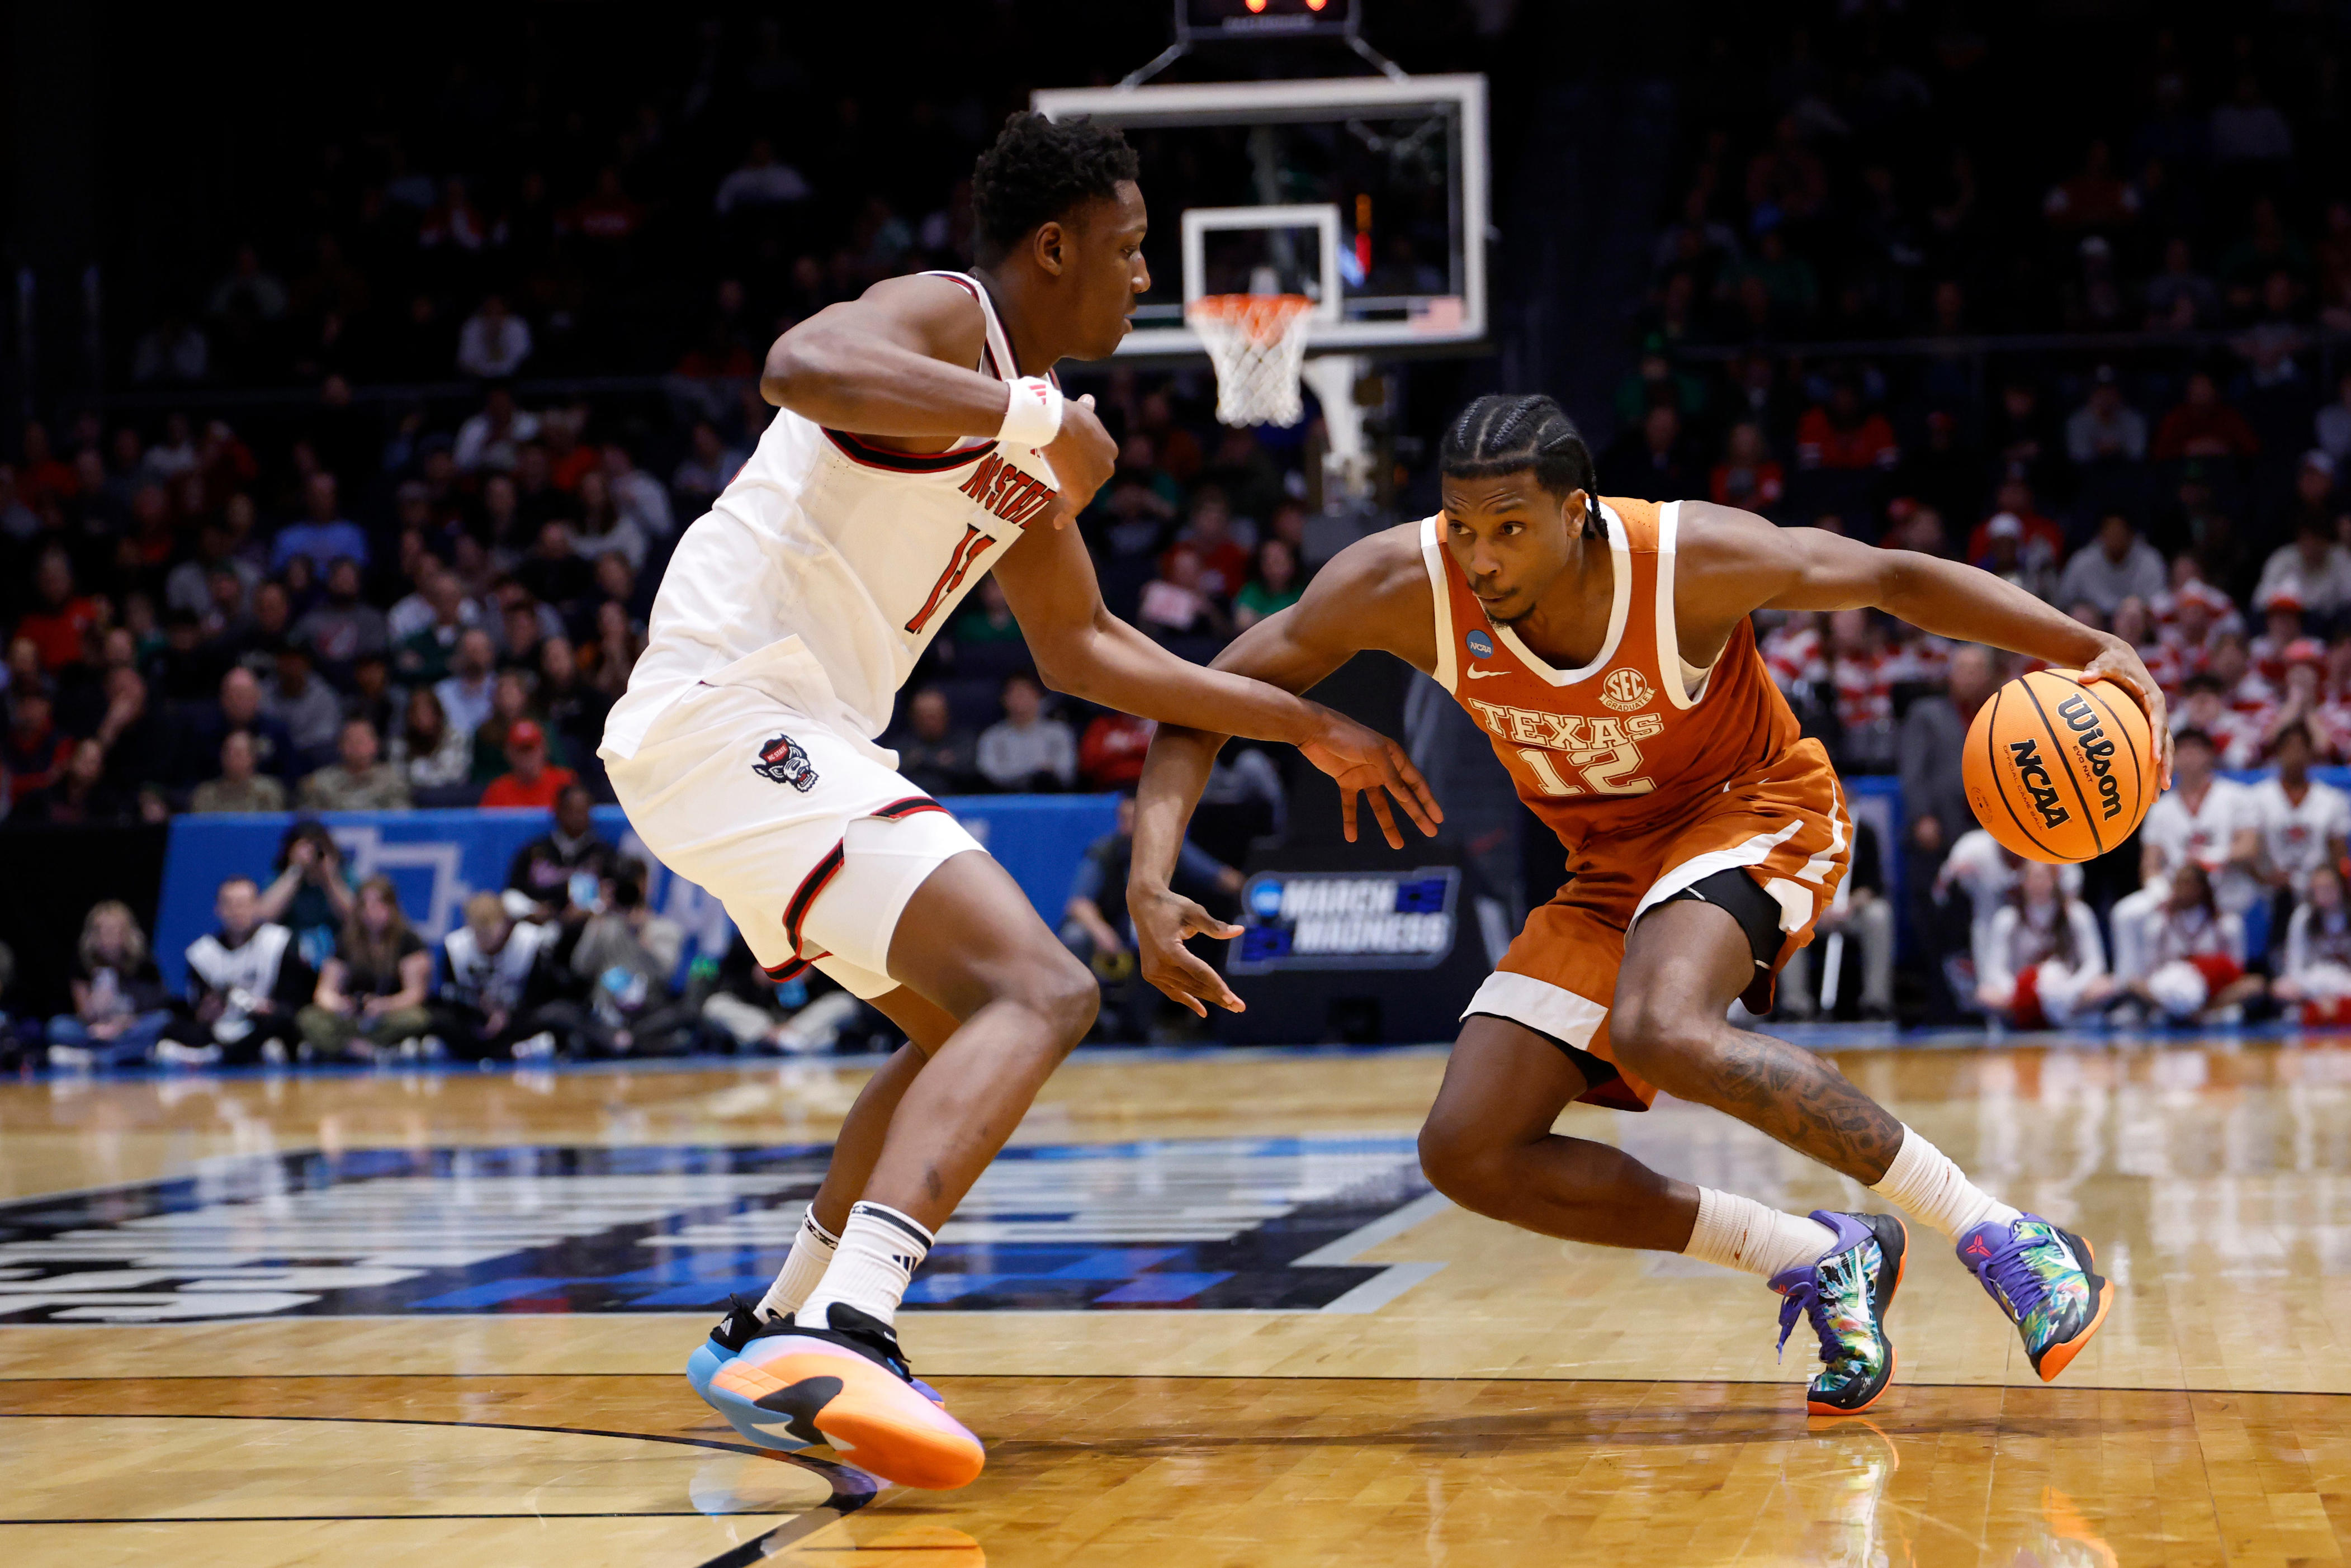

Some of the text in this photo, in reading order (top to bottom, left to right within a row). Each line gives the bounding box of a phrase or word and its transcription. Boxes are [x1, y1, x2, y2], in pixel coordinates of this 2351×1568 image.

[1470, 641, 1492, 654] NCAA
[1605, 695, 1650, 712] GRADUATE
[1607, 670, 1643, 701] SEC
[1467, 697, 1665, 752] TEXAS
[774, 746, 787, 757] STATE
[1516, 742, 1658, 796] 12
[2056, 691, 2122, 821] Wilson
[2073, 745, 2093, 783] EVO NXT
[2003, 745, 2042, 831] OFFICIAL GAME BALL
[2009, 738, 2071, 830] NCAA
[1280, 878, 1397, 918] MARCH
[1293, 912, 1449, 954] MADNESS
